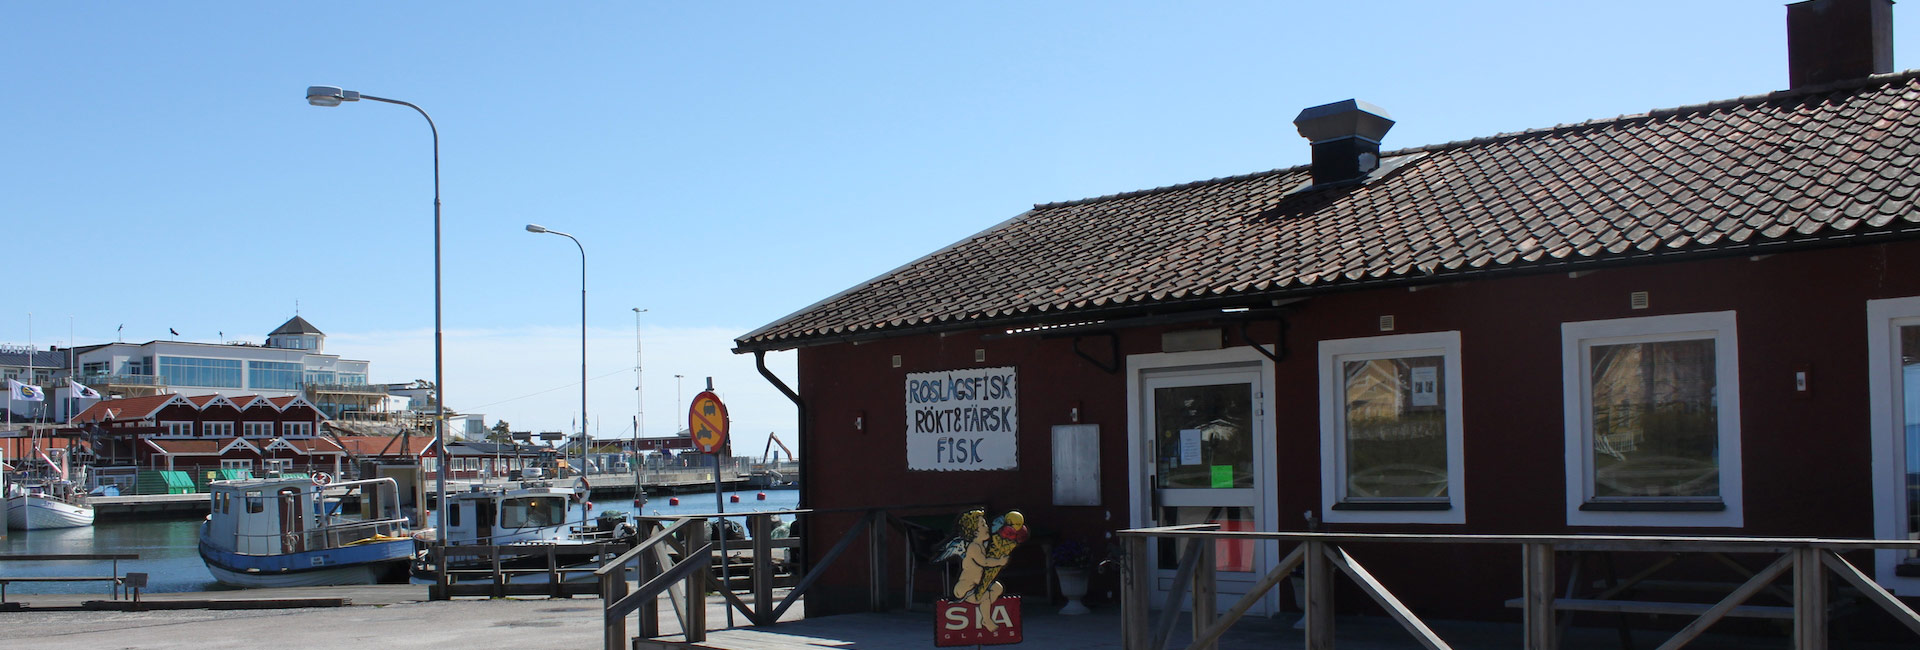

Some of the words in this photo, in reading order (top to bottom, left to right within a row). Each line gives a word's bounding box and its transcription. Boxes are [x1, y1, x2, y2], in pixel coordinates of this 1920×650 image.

[909, 372, 1013, 403] ROSLAGSFISK
[937, 437, 984, 464] FISK
[945, 605, 1013, 630] SIA
[945, 631, 1014, 639] GLASS
